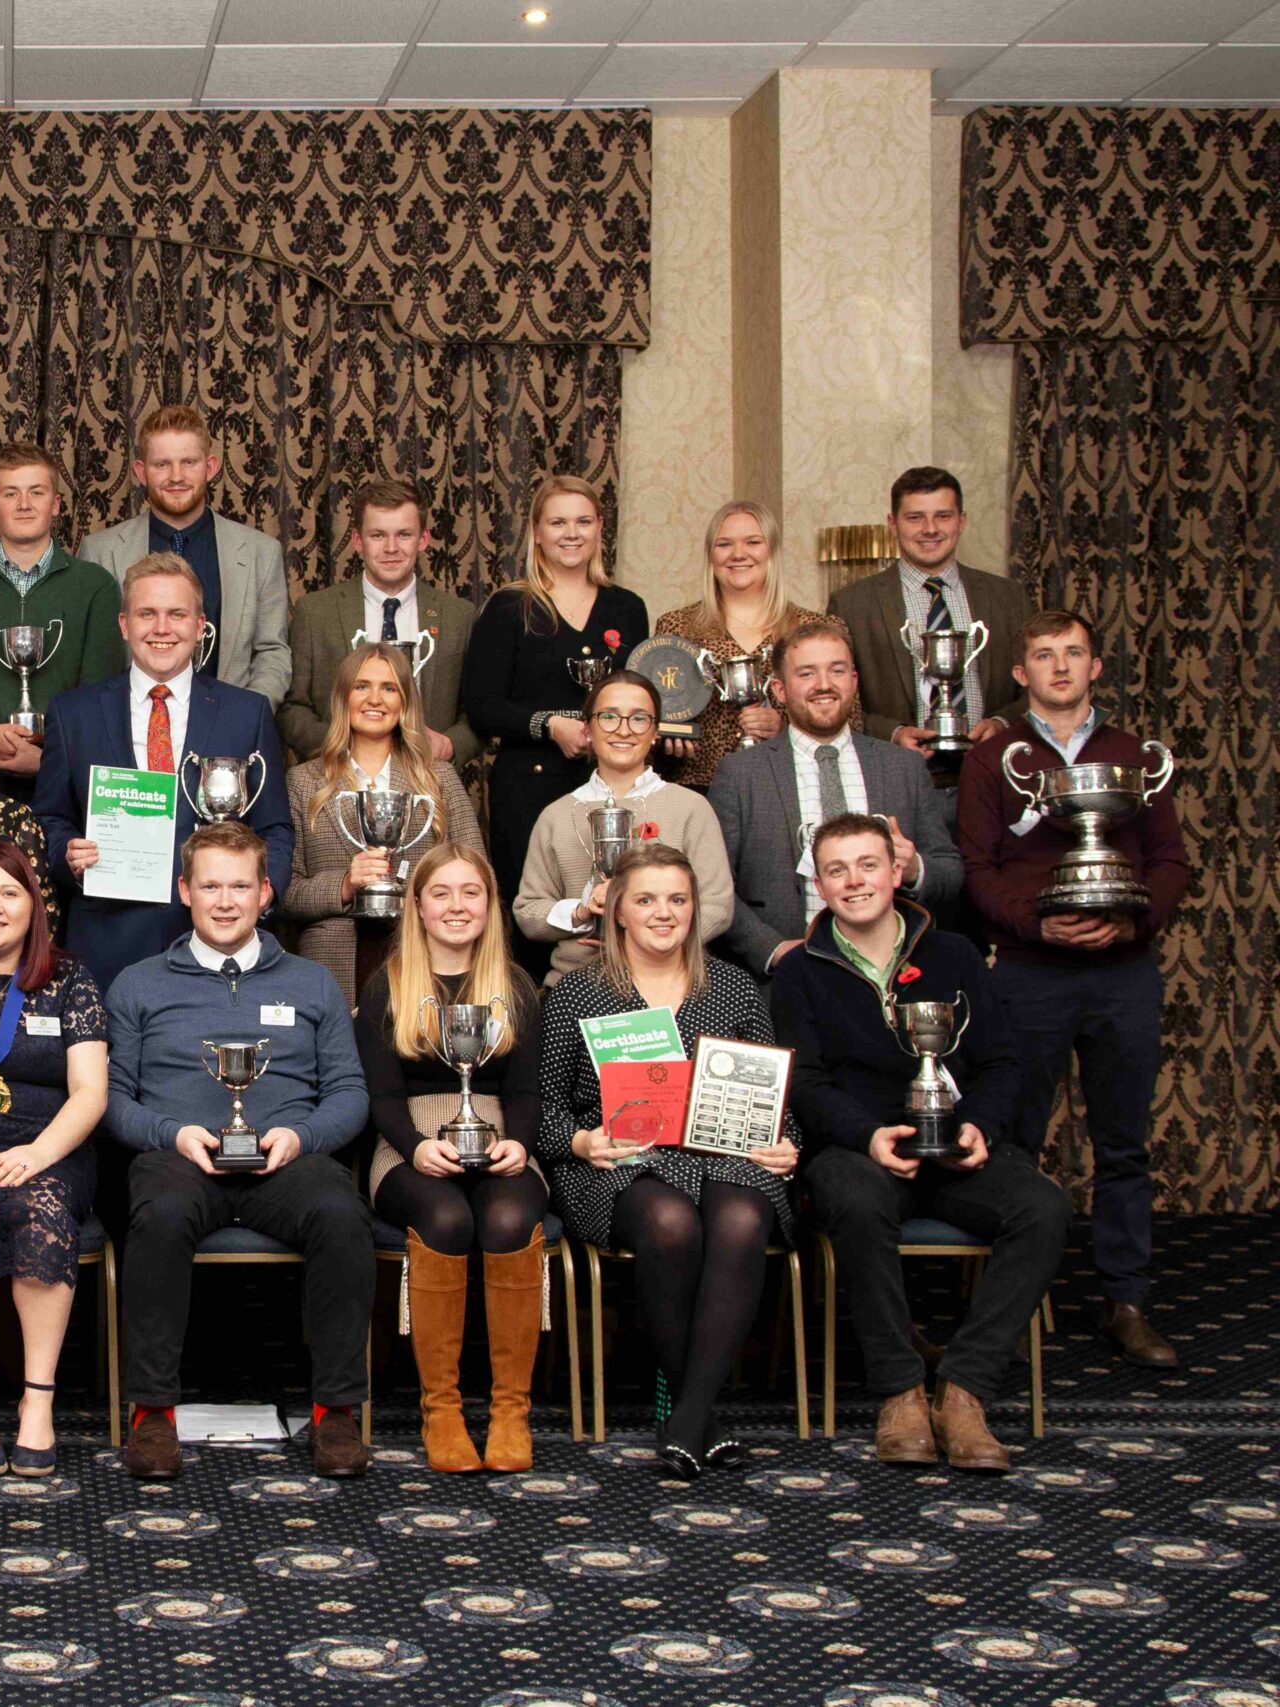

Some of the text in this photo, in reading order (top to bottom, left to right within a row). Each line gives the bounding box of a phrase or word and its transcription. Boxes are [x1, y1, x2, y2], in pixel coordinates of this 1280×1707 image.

[95, 785, 166, 803] Certificate
[127, 801, 166, 810] achievement
[593, 1030, 668, 1050] Certificate
[630, 1041, 671, 1053] achievement
